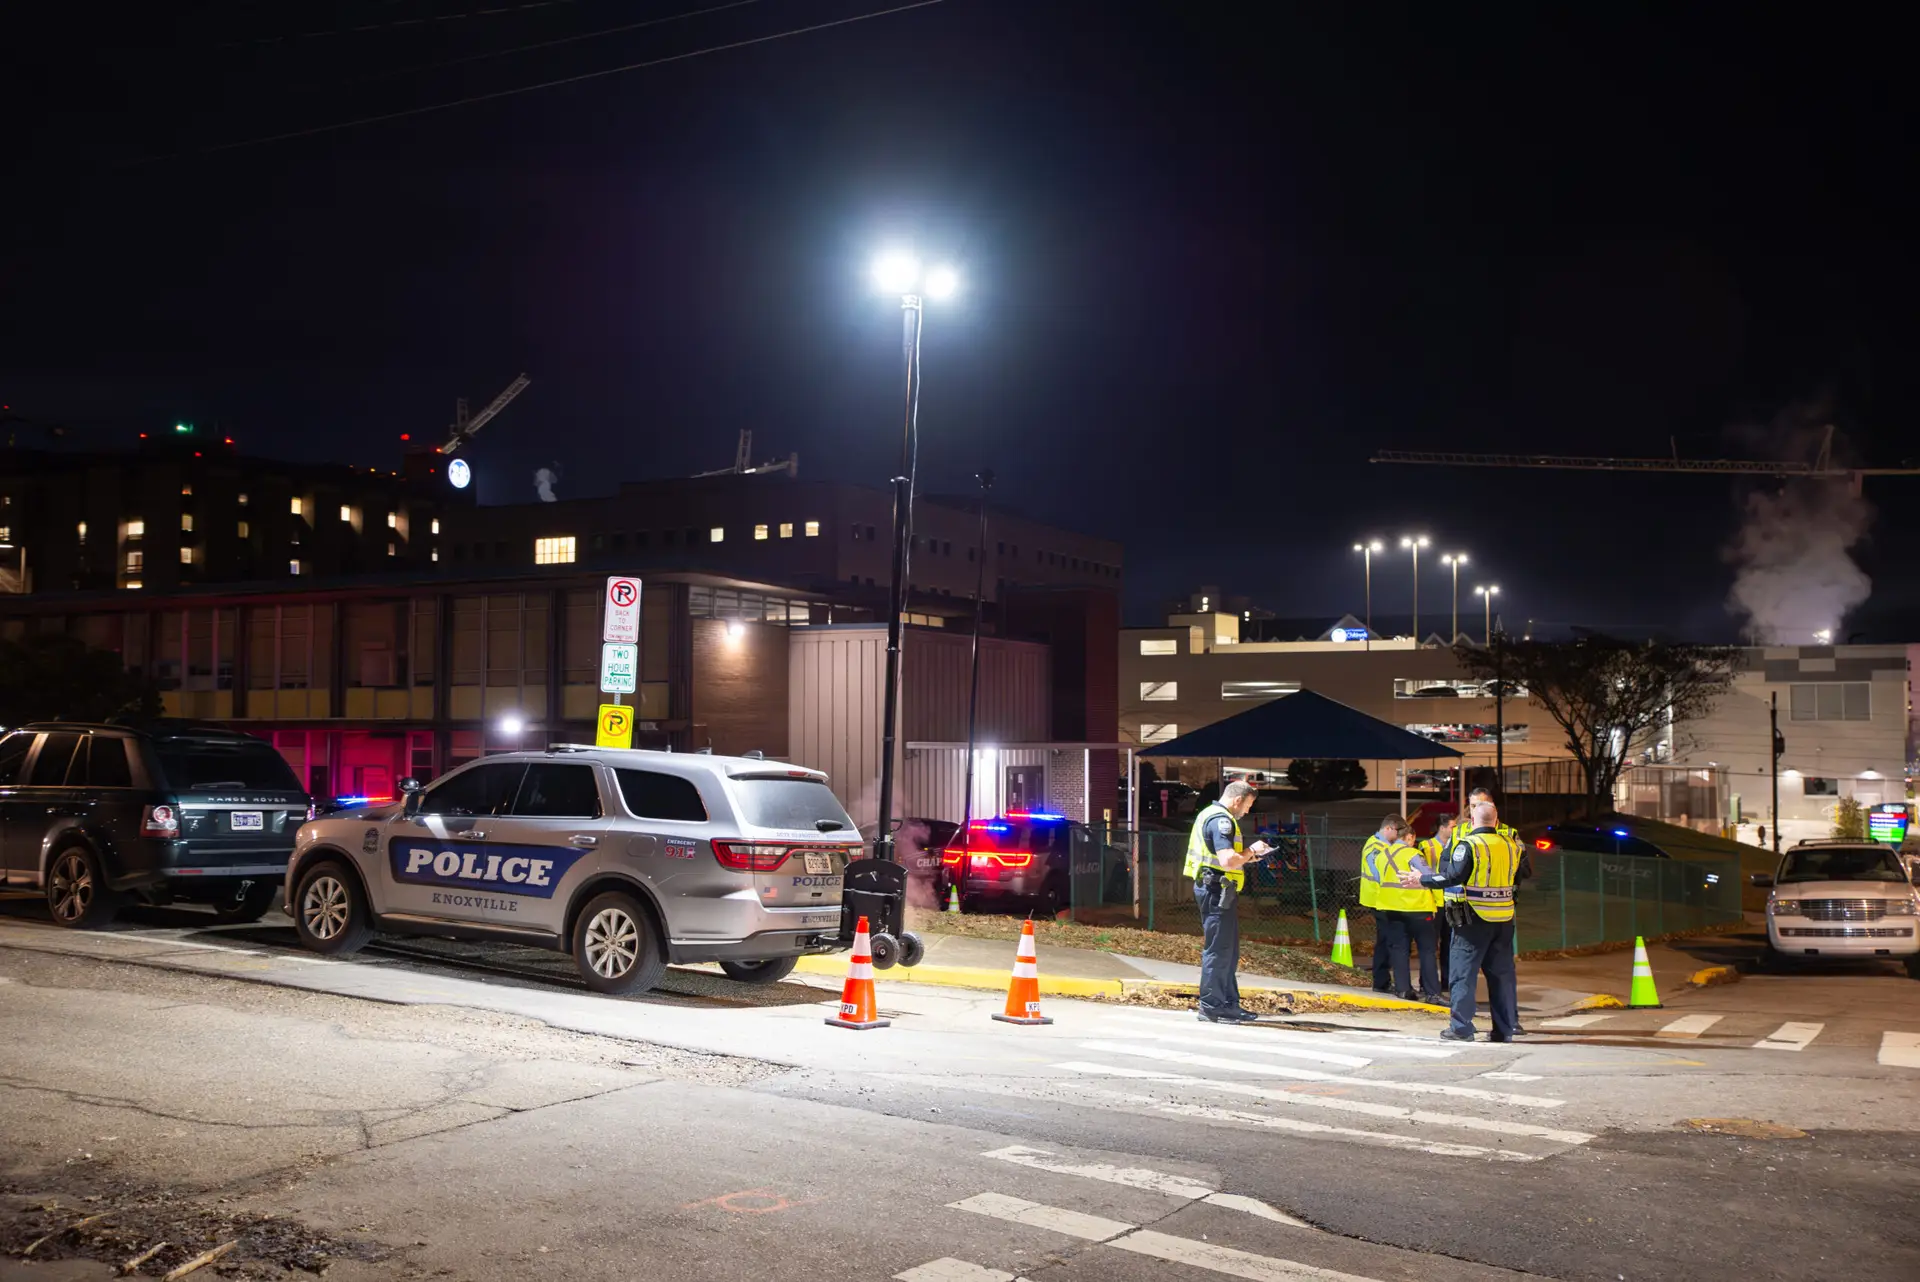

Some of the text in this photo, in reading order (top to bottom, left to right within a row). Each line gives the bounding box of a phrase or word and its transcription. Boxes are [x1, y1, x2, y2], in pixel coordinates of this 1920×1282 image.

[612, 650, 629, 660] TWO
[608, 663, 630, 673] HOUR
[604, 676, 632, 686] PARKING
[667, 839, 697, 847] EMERGENCY
[404, 849, 553, 886] POLICE
[792, 876, 842, 887] POLICE
[432, 893, 517, 911] KNOXVILLE
